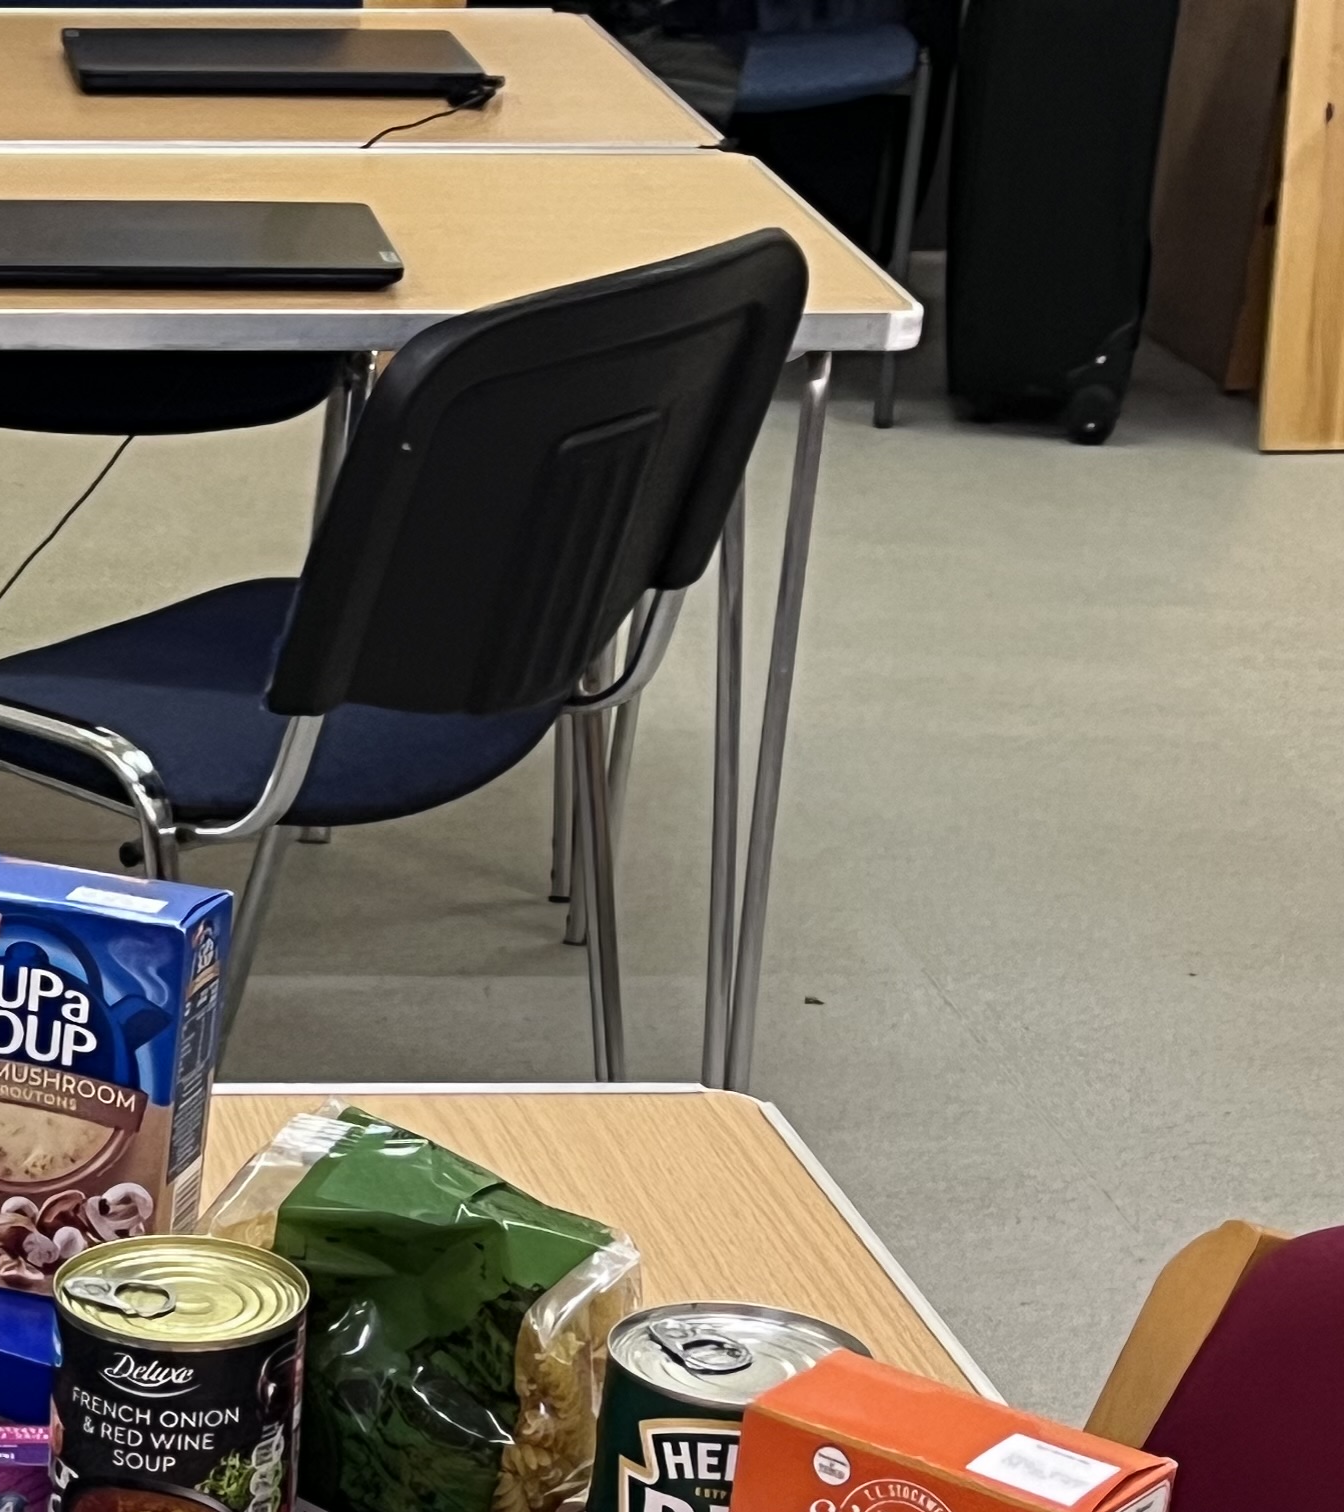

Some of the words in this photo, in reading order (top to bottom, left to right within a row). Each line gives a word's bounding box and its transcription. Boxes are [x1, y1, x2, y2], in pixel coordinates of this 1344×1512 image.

[104, 1352, 194, 1387] Deluxe
[72, 1386, 151, 1425] FRENCH
[160, 1407, 240, 1429] ONION
[82, 1416, 95, 1434] &
[100, 1422, 143, 1447] RED
[150, 1432, 215, 1451] WINE
[112, 1449, 176, 1473] SOUP
[663, 1441, 739, 1482] HEI
